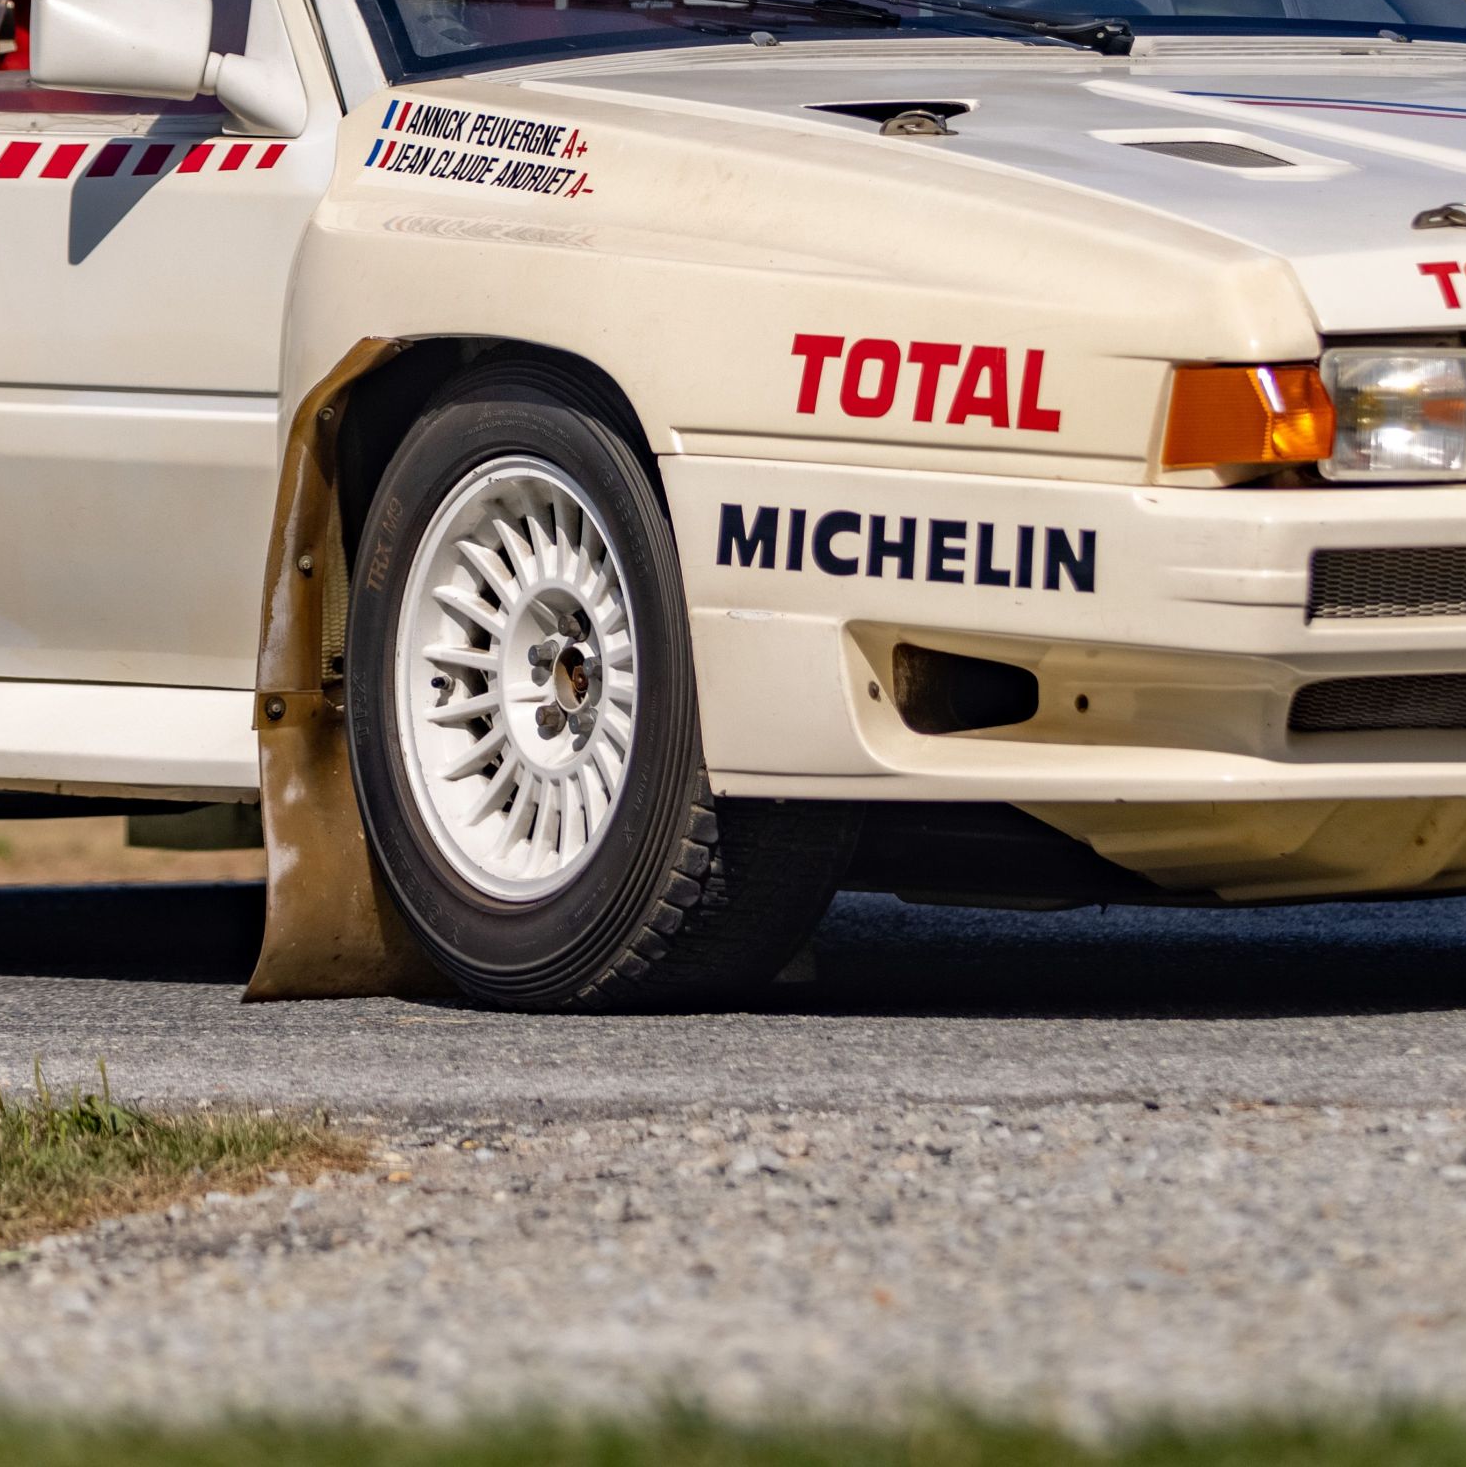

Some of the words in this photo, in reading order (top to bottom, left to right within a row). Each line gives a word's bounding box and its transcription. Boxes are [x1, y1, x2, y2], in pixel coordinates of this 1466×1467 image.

[406, 104, 474, 140] ANNICK
[466, 114, 567, 157] PEUVERGNE
[560, 129, 588, 160] A+
[387, 144, 437, 174] JEAN
[430, 151, 498, 186] CLAUDE
[493, 160, 576, 196] ANDRUET
[790, 333, 1061, 433] TOTAL
[366, 537, 392, 592] TRX
[716, 503, 1097, 594] MICHELIN
